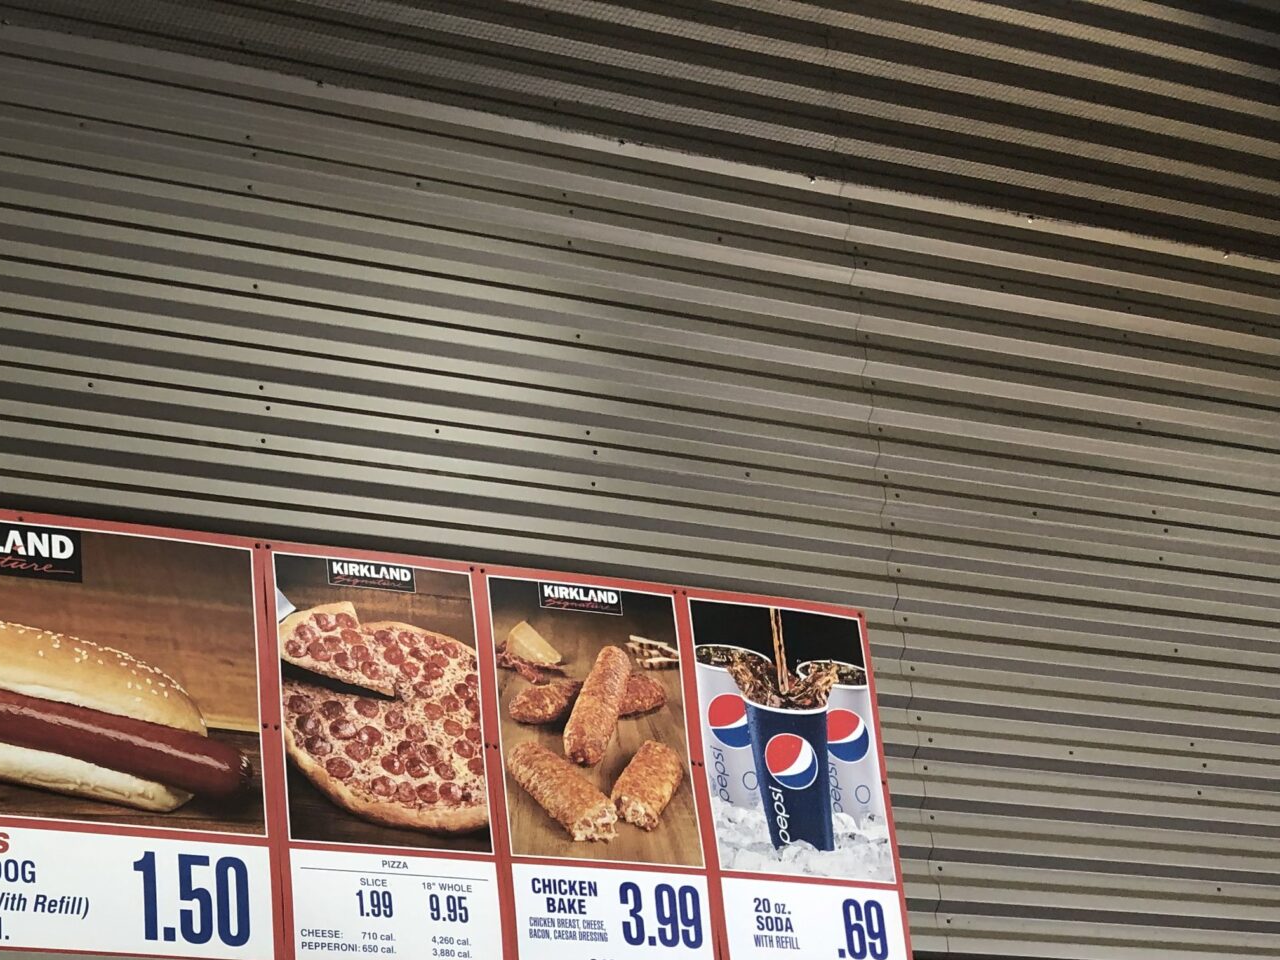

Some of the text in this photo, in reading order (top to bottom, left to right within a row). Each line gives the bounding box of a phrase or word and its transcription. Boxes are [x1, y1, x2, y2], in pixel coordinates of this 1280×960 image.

[332, 561, 411, 581] KIRKLAND
[543, 585, 618, 604] KIRKLAND
[710, 744, 734, 804] pepsi
[381, 860, 408, 869] PIZZA
[360, 878, 387, 887] SLICE
[439, 883, 472, 893] WHOLE
[531, 877, 598, 897] CHICKEN
[33, 894, 90, 919] Refill)
[133, 851, 250, 947] 1.50
[356, 889, 393, 918] 1.99
[429, 894, 469, 923] 9.95
[546, 897, 587, 915] BAKE
[753, 897, 792, 915] 20 oz.
[529, 916, 606, 931] CHICKEN BREAST, CHEESE,
[619, 881, 703, 949] 3.99
[756, 915, 794, 933] SODA
[300, 928, 471, 947] CHEESE: 710 cal. 4,260 cal.
[529, 929, 608, 942] BACON, CAESAR DRESSING
[837, 898, 889, 960] .69
[301, 941, 473, 959] PEPPERONI: 650 cal. 3,880 cal.
[753, 934, 801, 950] WITH REFILL
